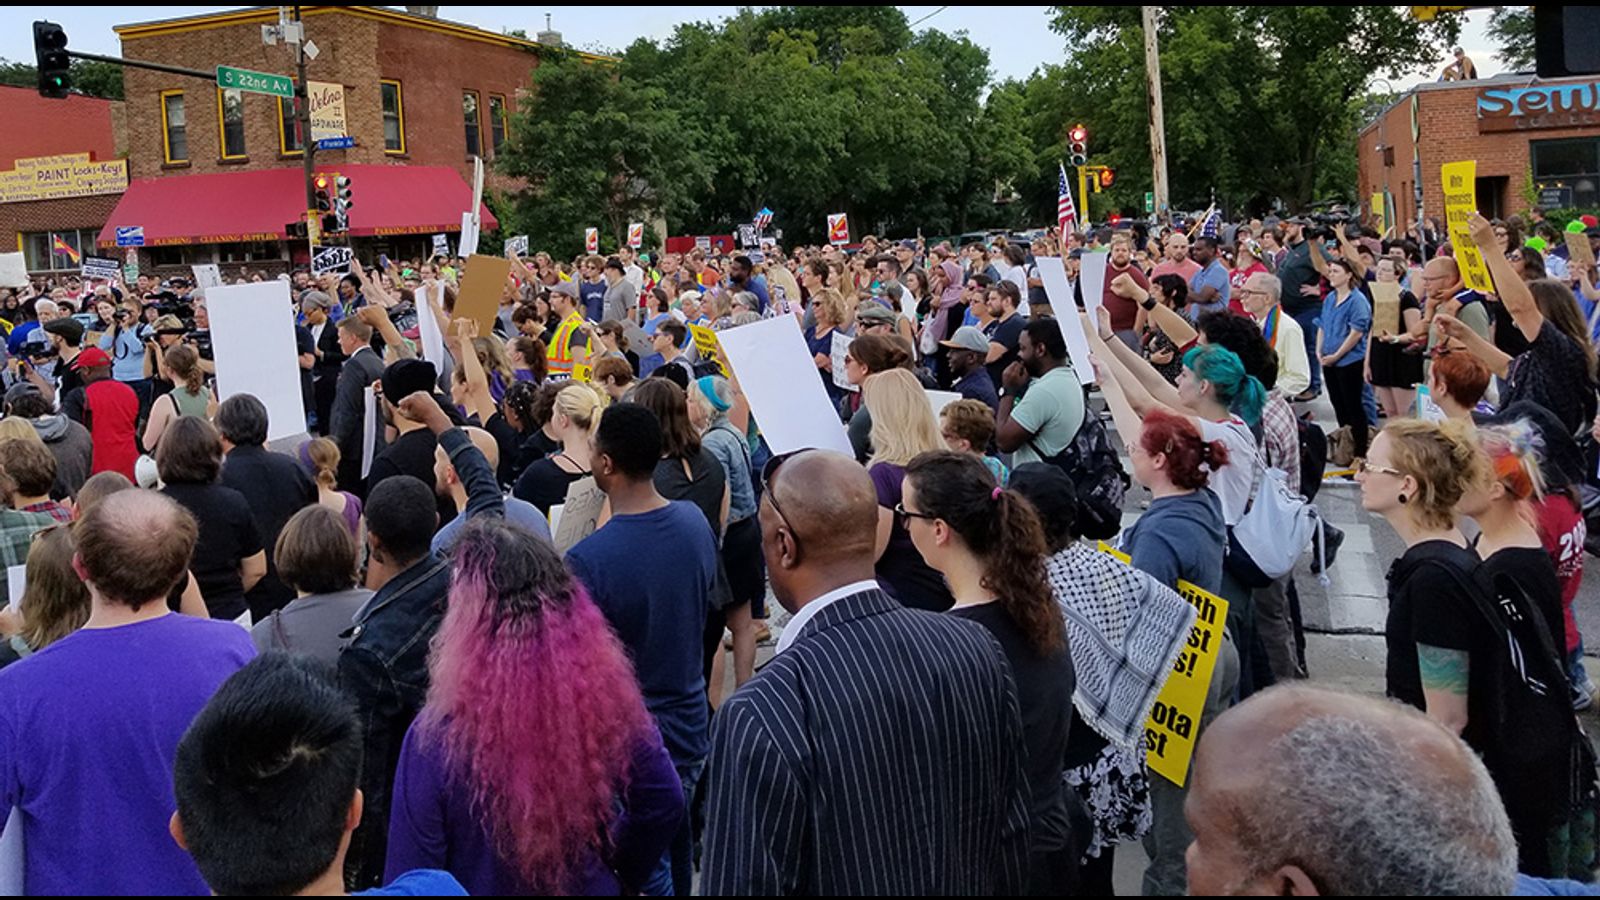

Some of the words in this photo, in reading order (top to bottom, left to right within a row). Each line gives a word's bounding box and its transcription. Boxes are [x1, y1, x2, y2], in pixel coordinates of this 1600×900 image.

[225, 72, 233, 84] S
[239, 74, 267, 89] 22nd
[273, 80, 288, 92] Av
[37, 167, 70, 181] PAINT
[1152, 701, 1192, 739] ota
